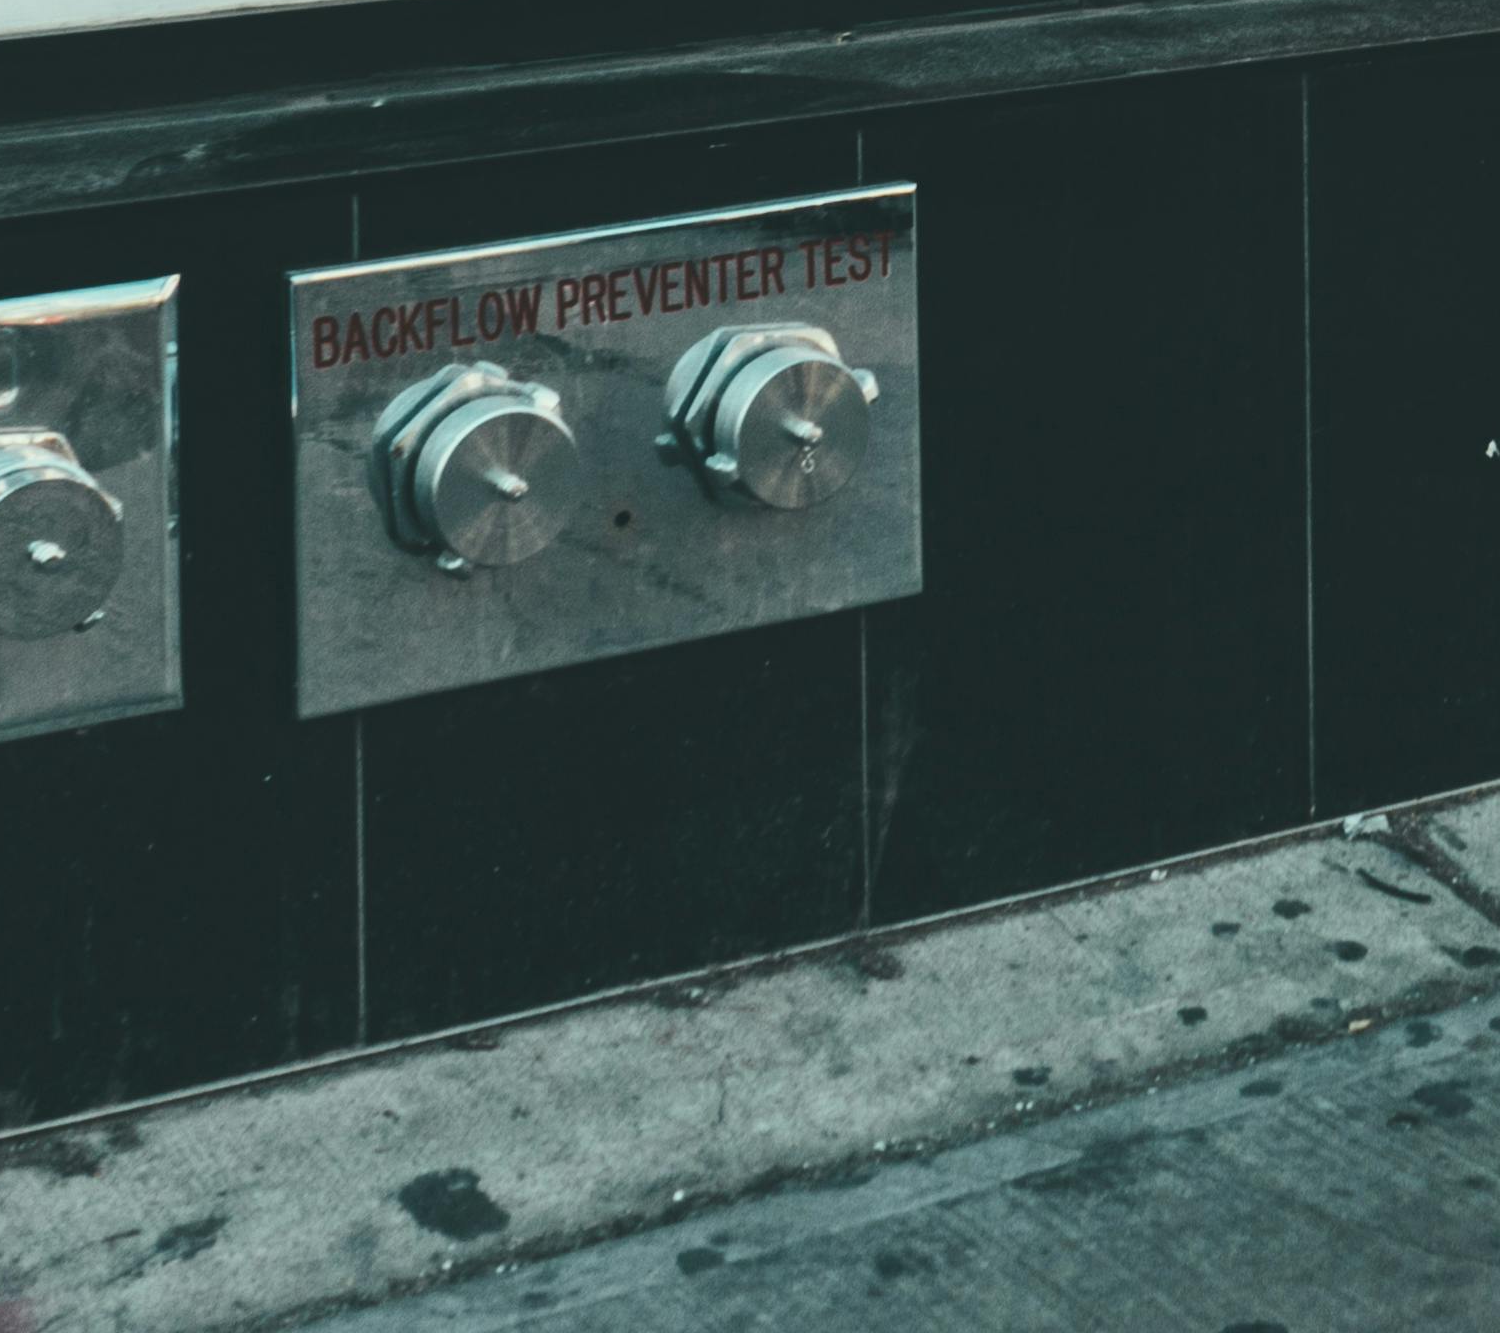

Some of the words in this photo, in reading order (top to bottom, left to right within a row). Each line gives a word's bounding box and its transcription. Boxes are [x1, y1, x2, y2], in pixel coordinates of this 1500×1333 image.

[311, 284, 544, 370] BACKFLOW
[555, 245, 786, 331] PREVENTER
[799, 232, 893, 290] TEST
